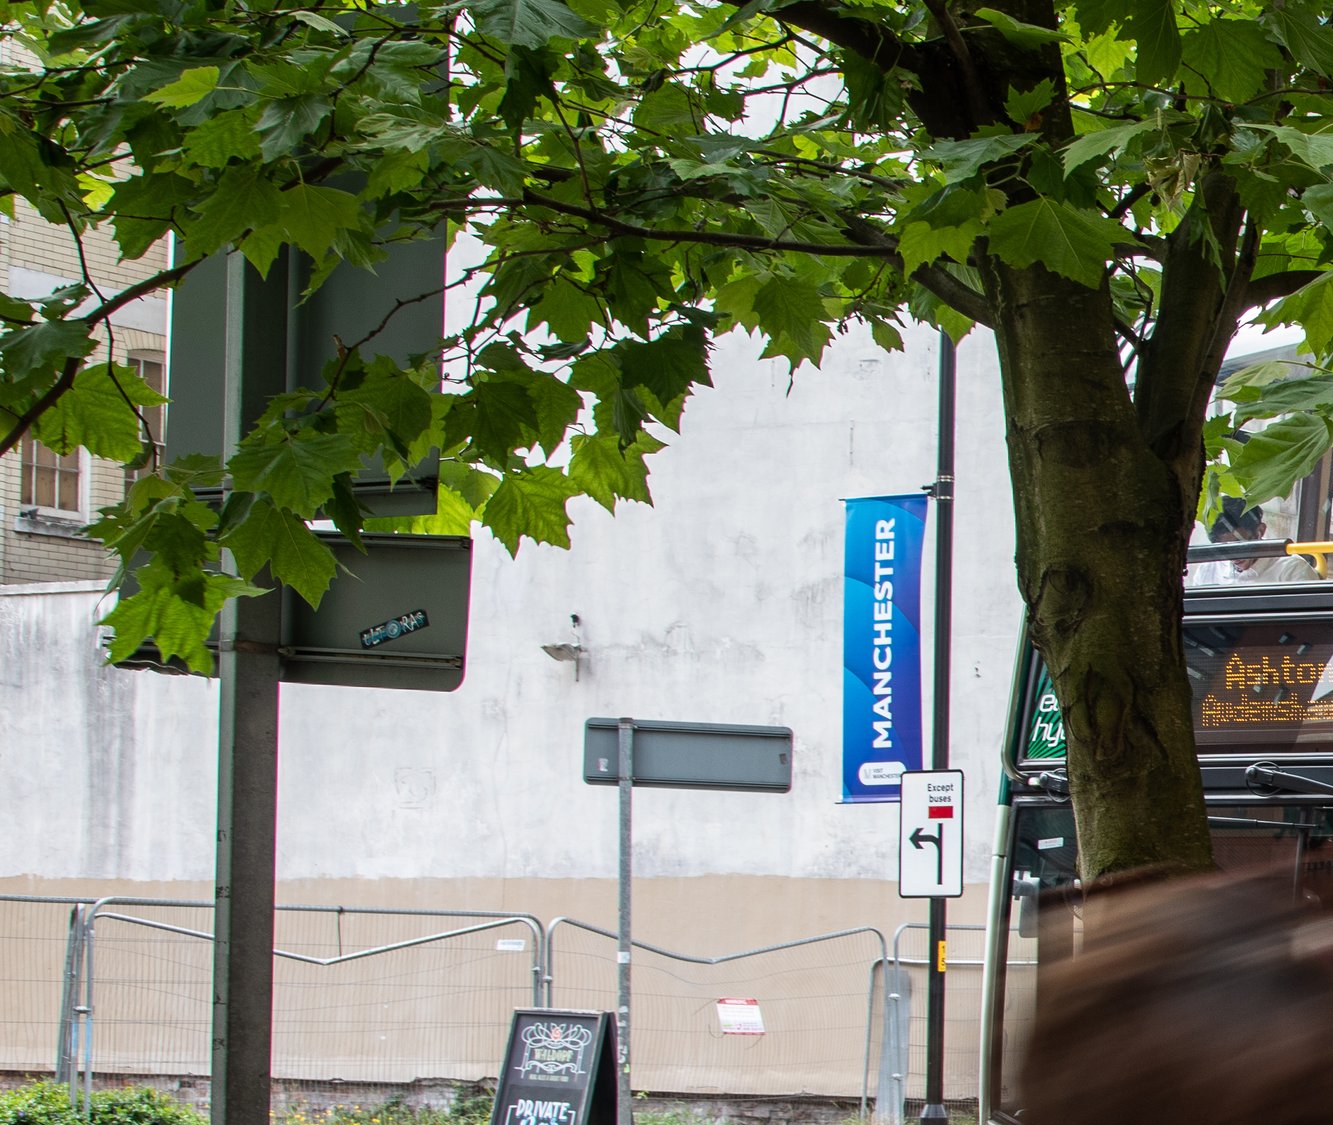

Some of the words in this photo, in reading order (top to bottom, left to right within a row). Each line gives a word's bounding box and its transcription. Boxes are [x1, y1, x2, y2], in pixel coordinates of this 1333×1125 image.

[872, 517, 896, 749] MANCHESTER
[927, 783, 954, 793] Except
[929, 794, 952, 803] buses
[515, 1099, 570, 1120] PRIVATE
